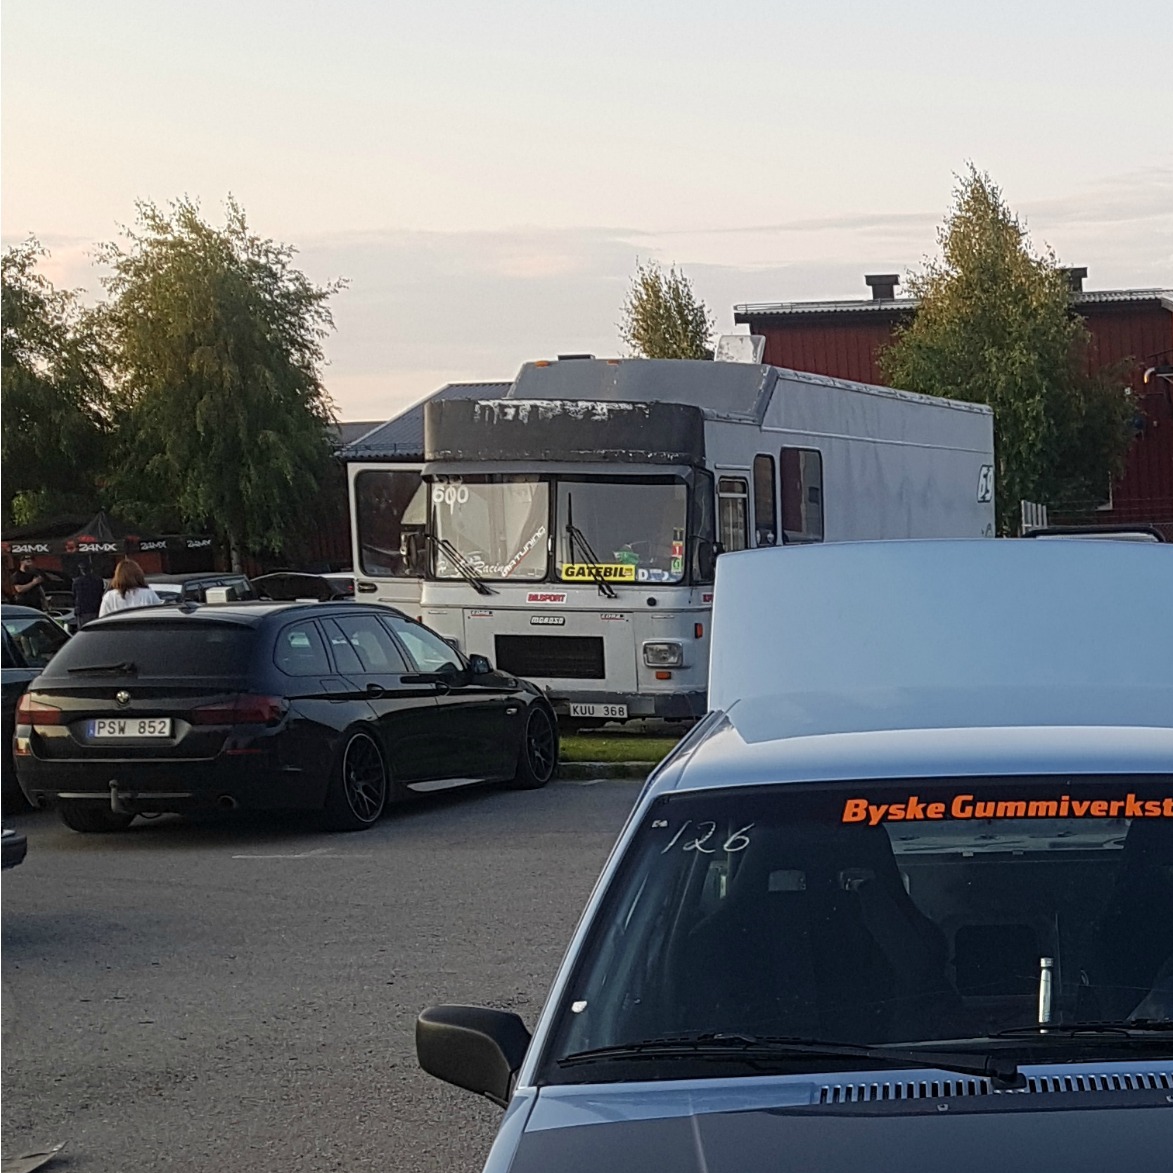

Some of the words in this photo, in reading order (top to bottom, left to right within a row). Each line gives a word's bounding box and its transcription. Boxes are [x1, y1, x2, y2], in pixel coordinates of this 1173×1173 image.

[11, 543, 50, 554] 24MX
[78, 542, 118, 552] 24MX
[140, 540, 168, 551] 24MX
[564, 565, 626, 578] GATEBIL
[527, 593, 566, 603] BILSPORT
[572, 705, 595, 716] KUU
[603, 706, 625, 716] 368
[97, 720, 126, 735] PSW
[138, 720, 167, 735] 852
[842, 796, 945, 827] Byske
[660, 819, 756, 855] 126
